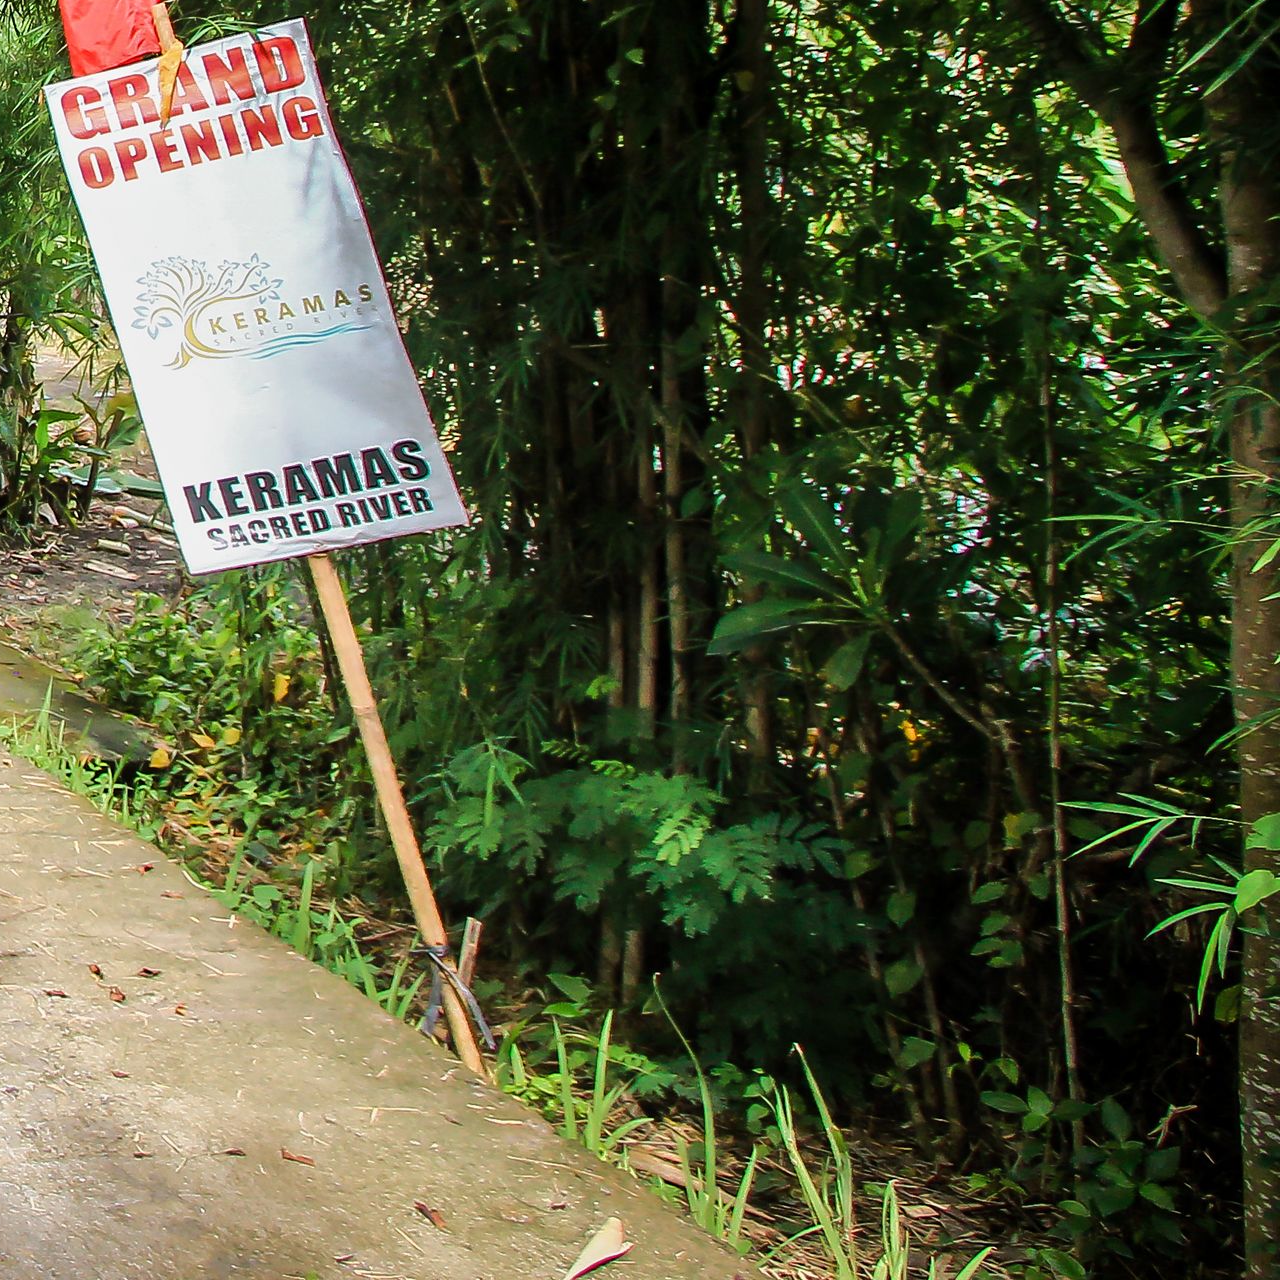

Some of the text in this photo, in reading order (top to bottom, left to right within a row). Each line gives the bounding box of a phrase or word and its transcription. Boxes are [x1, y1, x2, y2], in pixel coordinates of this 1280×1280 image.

[61, 36, 306, 140] GRAND
[78, 96, 324, 189] OPENING
[208, 284, 373, 335] KERAMAS
[214, 305, 378, 346] SACRED RIVER
[183, 440, 431, 523] KERAMAS
[207, 487, 434, 550] SACRED RIVER
